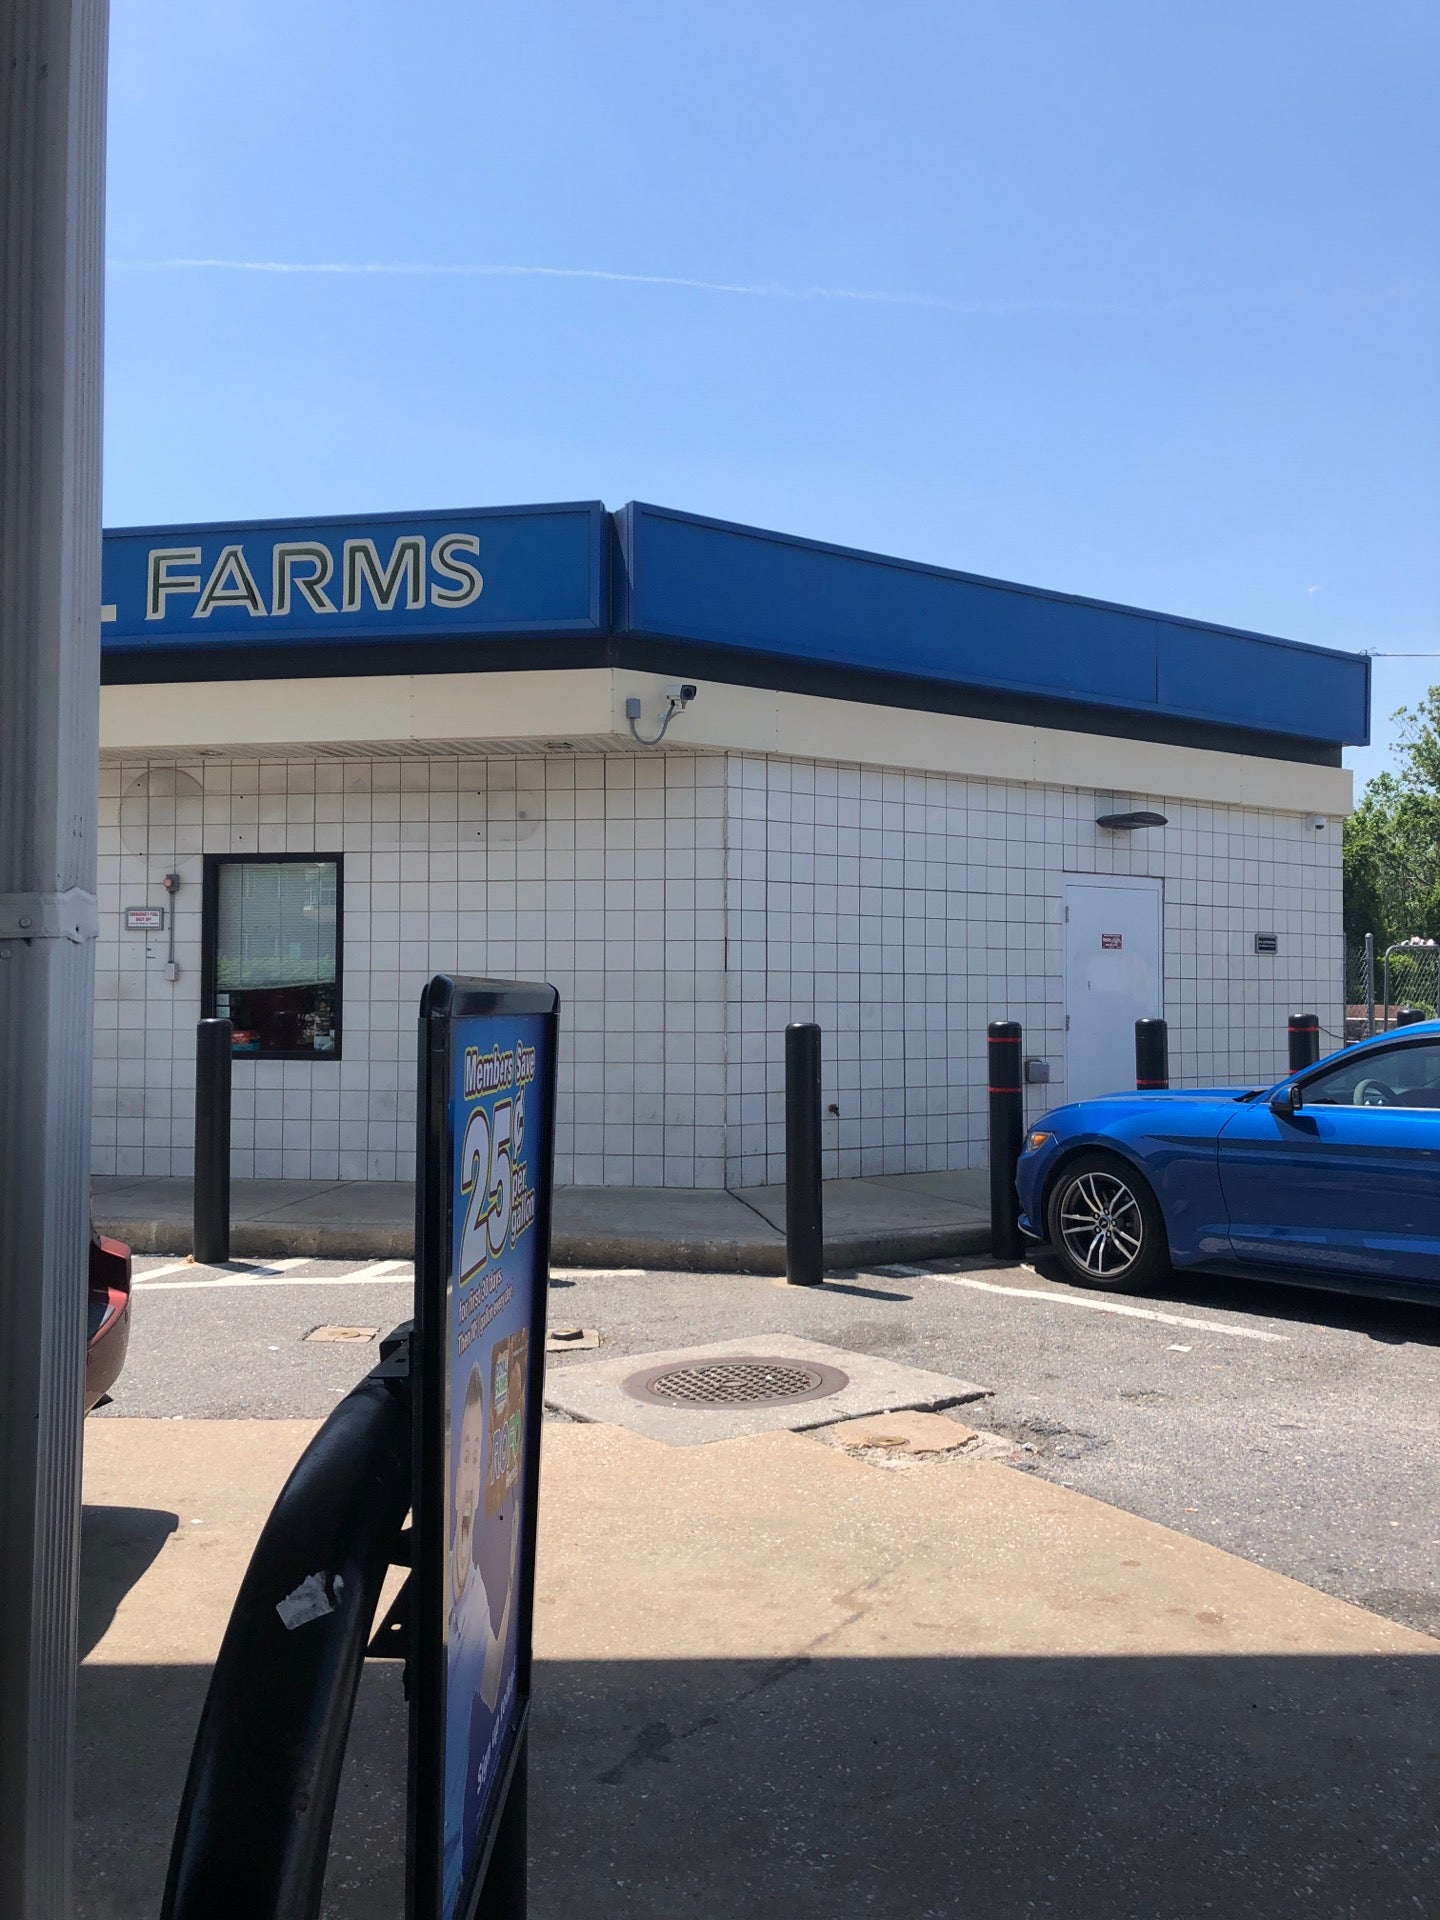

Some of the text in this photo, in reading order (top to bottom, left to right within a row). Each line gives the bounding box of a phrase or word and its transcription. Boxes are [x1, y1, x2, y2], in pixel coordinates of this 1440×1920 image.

[145, 533, 484, 621] FARMS
[464, 1040, 536, 1101] Members Save
[510, 1188, 535, 1249] gallon
